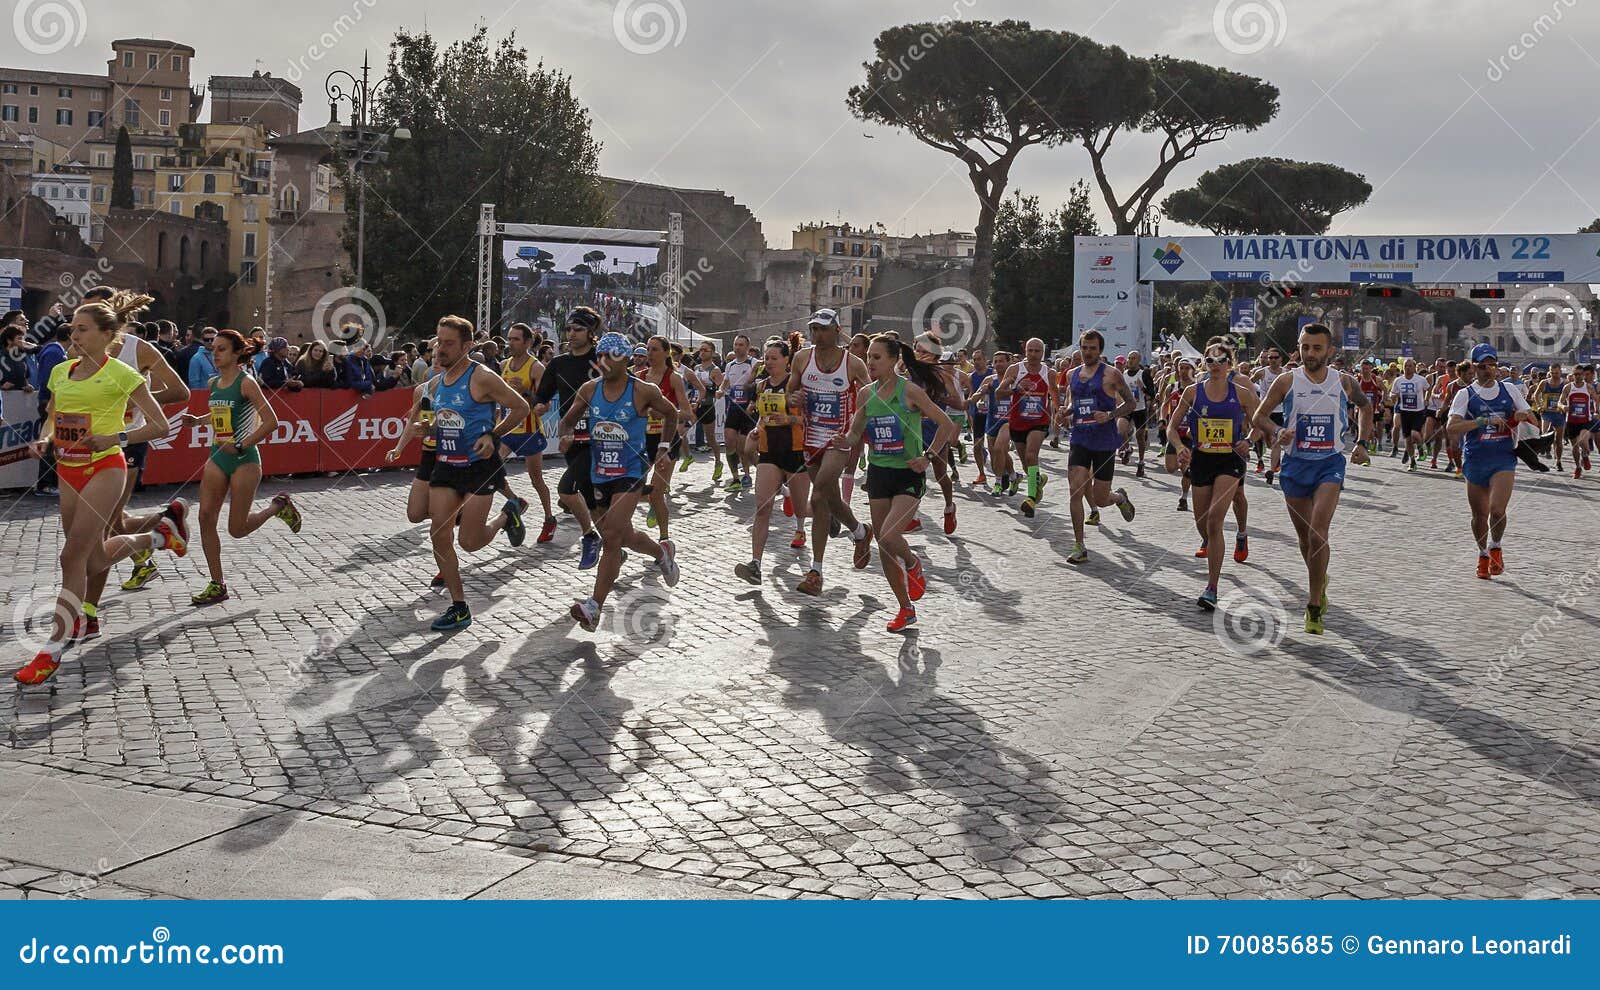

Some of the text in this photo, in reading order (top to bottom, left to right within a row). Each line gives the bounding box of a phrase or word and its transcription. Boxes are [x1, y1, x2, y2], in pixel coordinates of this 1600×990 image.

[1223, 236, 1550, 260] MARATONA di ROMA 22
[1319, 288, 1350, 296] TIMEX
[1422, 289, 1452, 297] TIMEX
[188, 419, 318, 448] HDA
[874, 427, 893, 438] F96
[1305, 425, 1326, 437] 142
[441, 440, 457, 451] 311
[600, 451, 620, 464] 252
